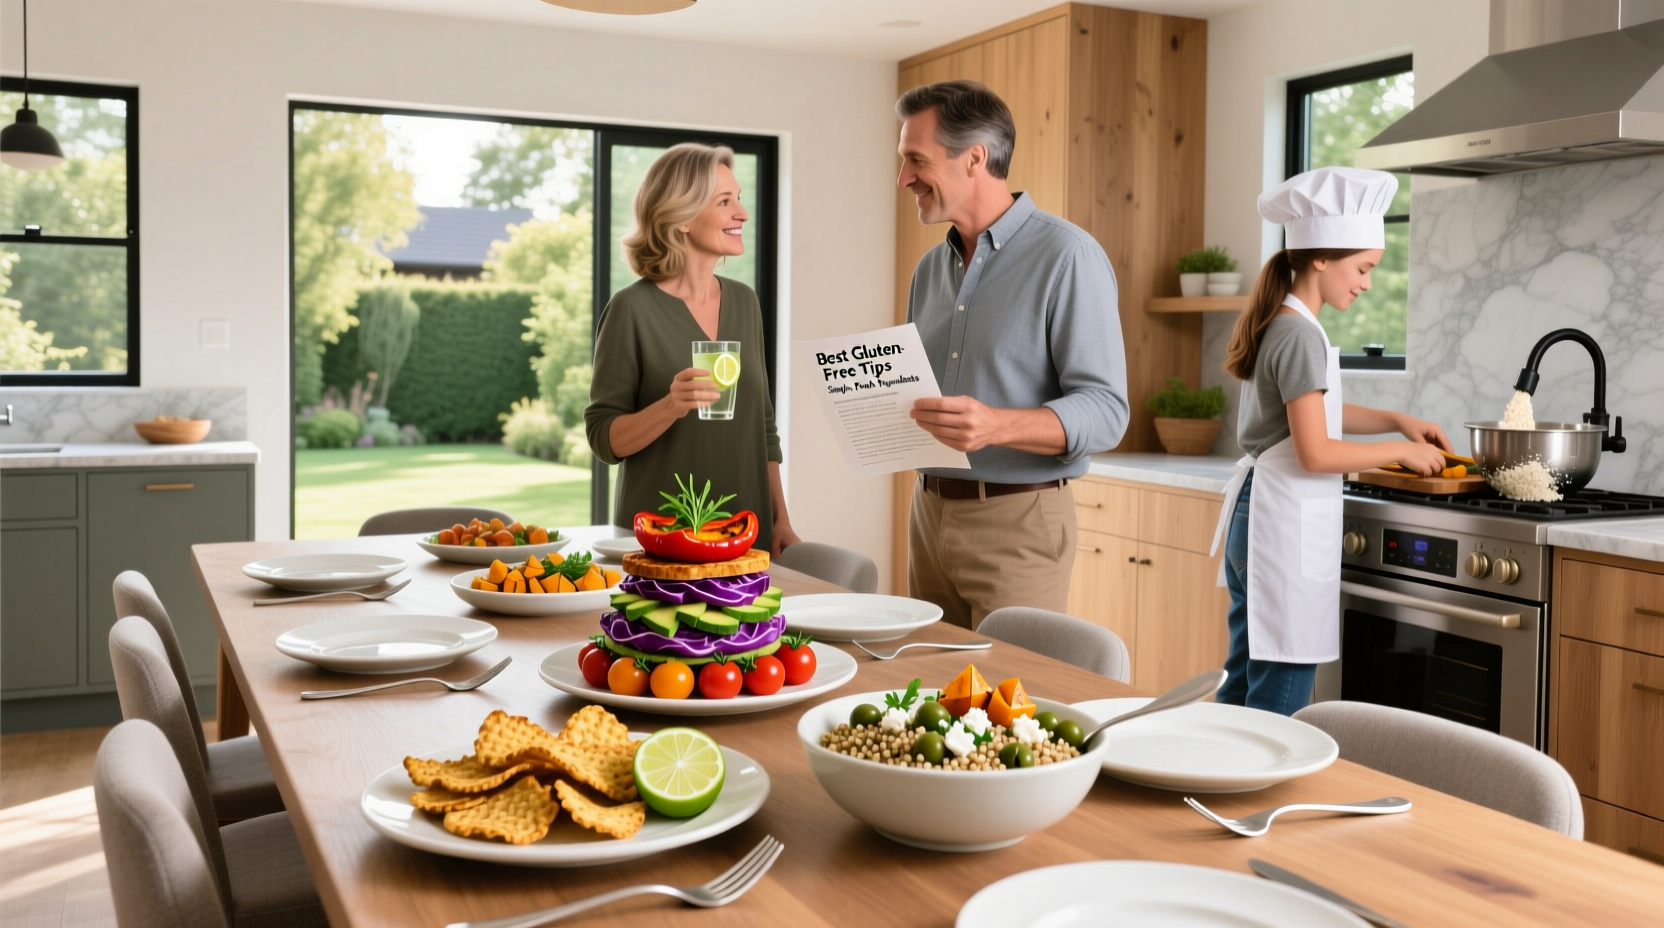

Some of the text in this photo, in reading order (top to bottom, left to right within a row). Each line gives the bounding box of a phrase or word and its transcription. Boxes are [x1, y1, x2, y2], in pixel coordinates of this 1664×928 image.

[816, 344, 905, 365] Best Gluten-
[858, 361, 892, 378] Tips
